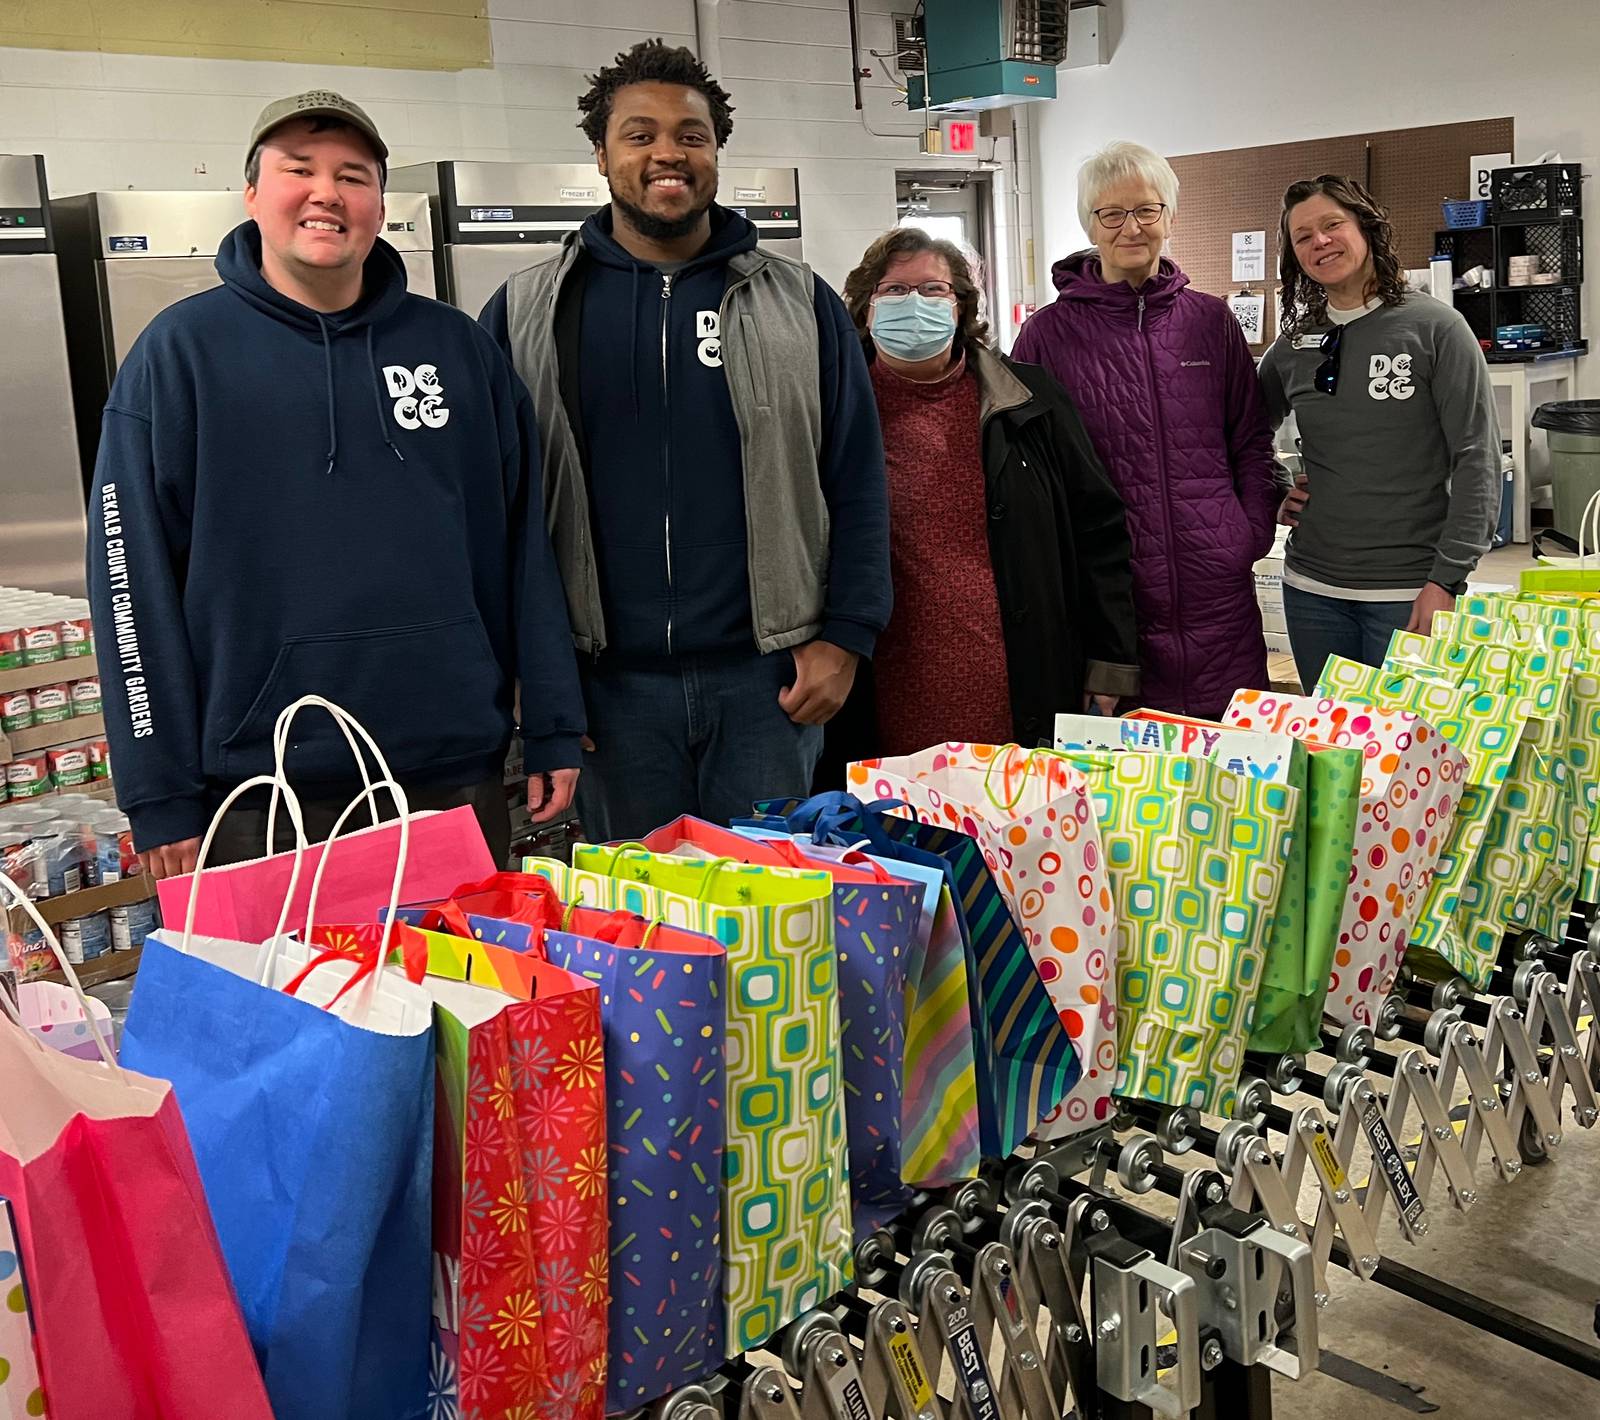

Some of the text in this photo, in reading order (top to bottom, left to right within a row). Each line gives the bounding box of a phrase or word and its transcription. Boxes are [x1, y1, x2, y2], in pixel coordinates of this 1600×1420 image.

[950, 123, 974, 151] EXIT
[102, 483, 154, 739] DEKALB COUNTY COMMUNITY GARDENS
[1120, 720, 1221, 757] HAPPY
[1364, 1106, 1377, 1123] 200
[1372, 1122, 1413, 1204] BEST FLEX
[948, 1306, 967, 1327] 200
[957, 1329, 980, 1376] BEST
